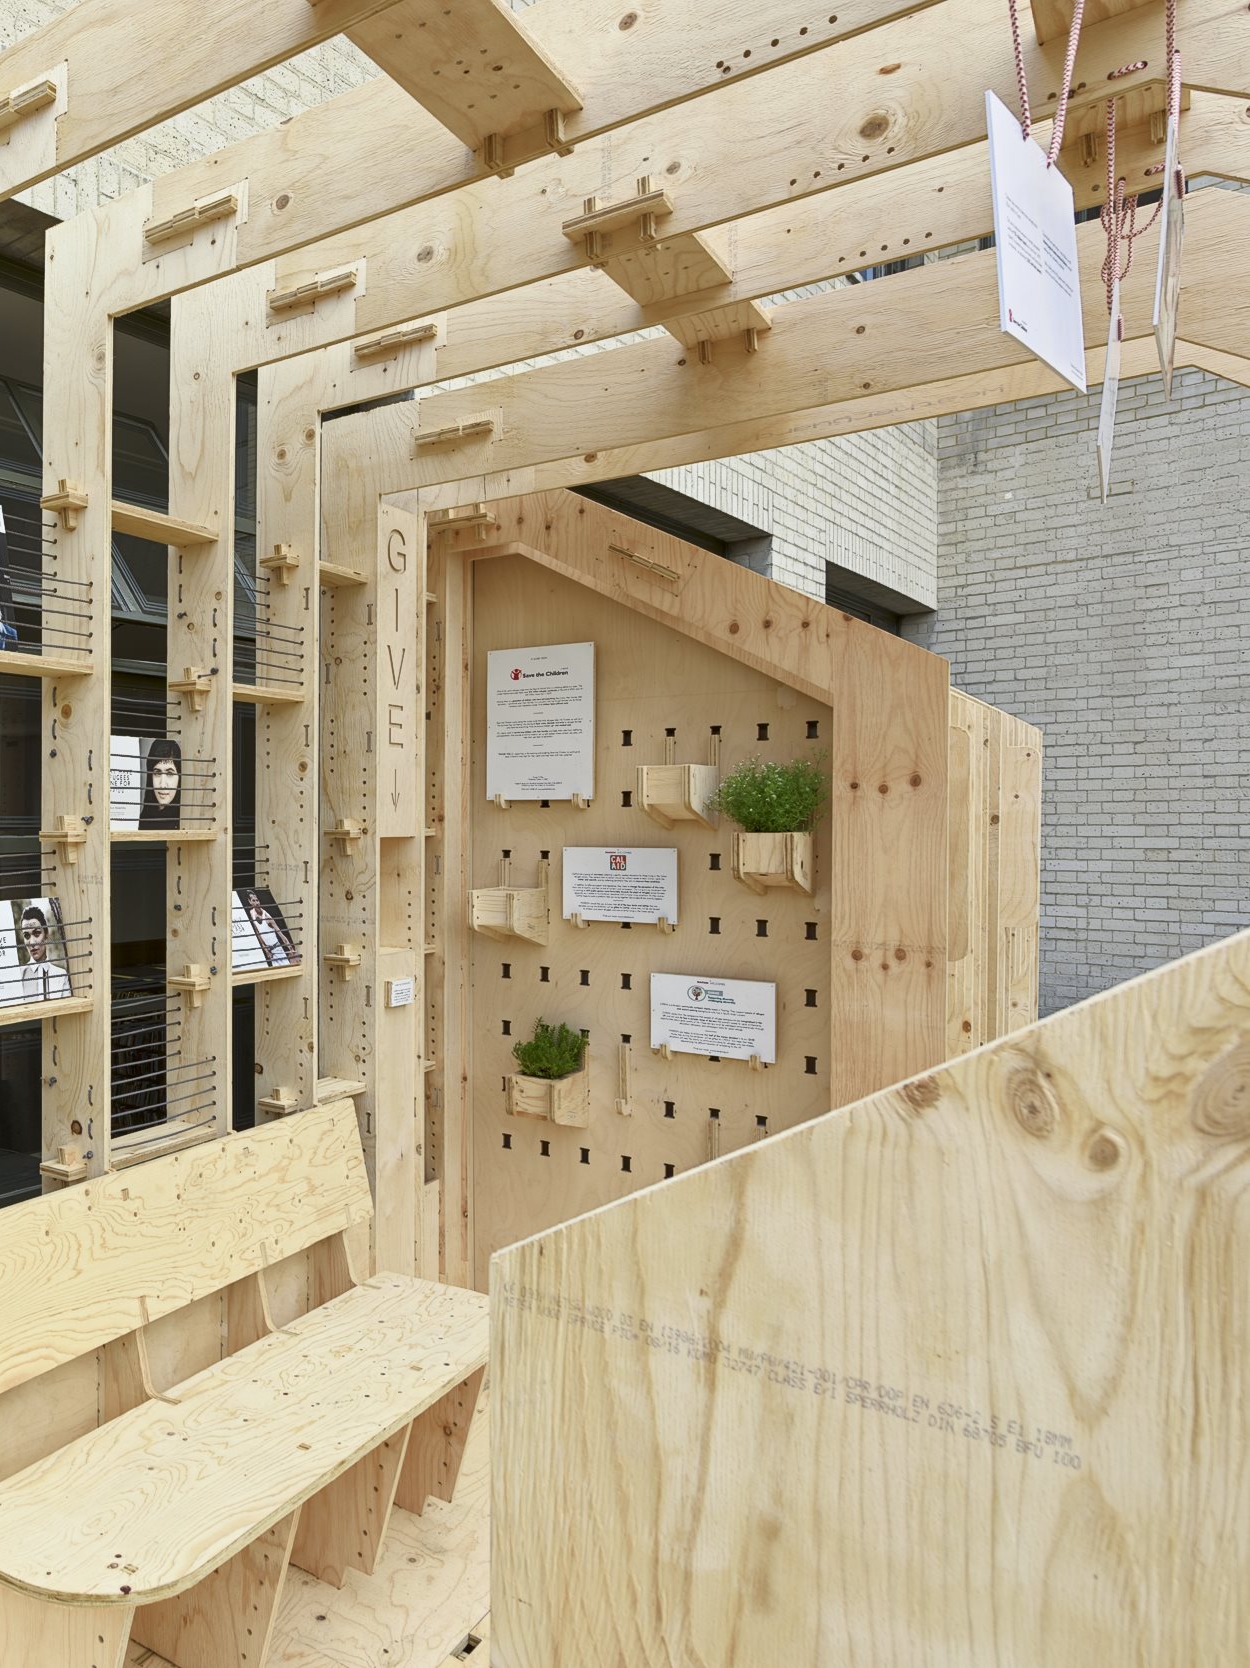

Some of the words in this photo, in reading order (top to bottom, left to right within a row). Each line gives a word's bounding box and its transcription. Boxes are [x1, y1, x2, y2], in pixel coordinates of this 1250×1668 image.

[386, 528, 407, 749] GIVE
[611, 855, 625, 863] CAL
[611, 862, 626, 870] AID
[638, 1318, 653, 1332] EN
[912, 1393, 929, 1411] EN
[767, 1369, 806, 1391] CLASS
[844, 1390, 920, 1424] SPERRHOLZ
[927, 1414, 955, 1435] DIN
